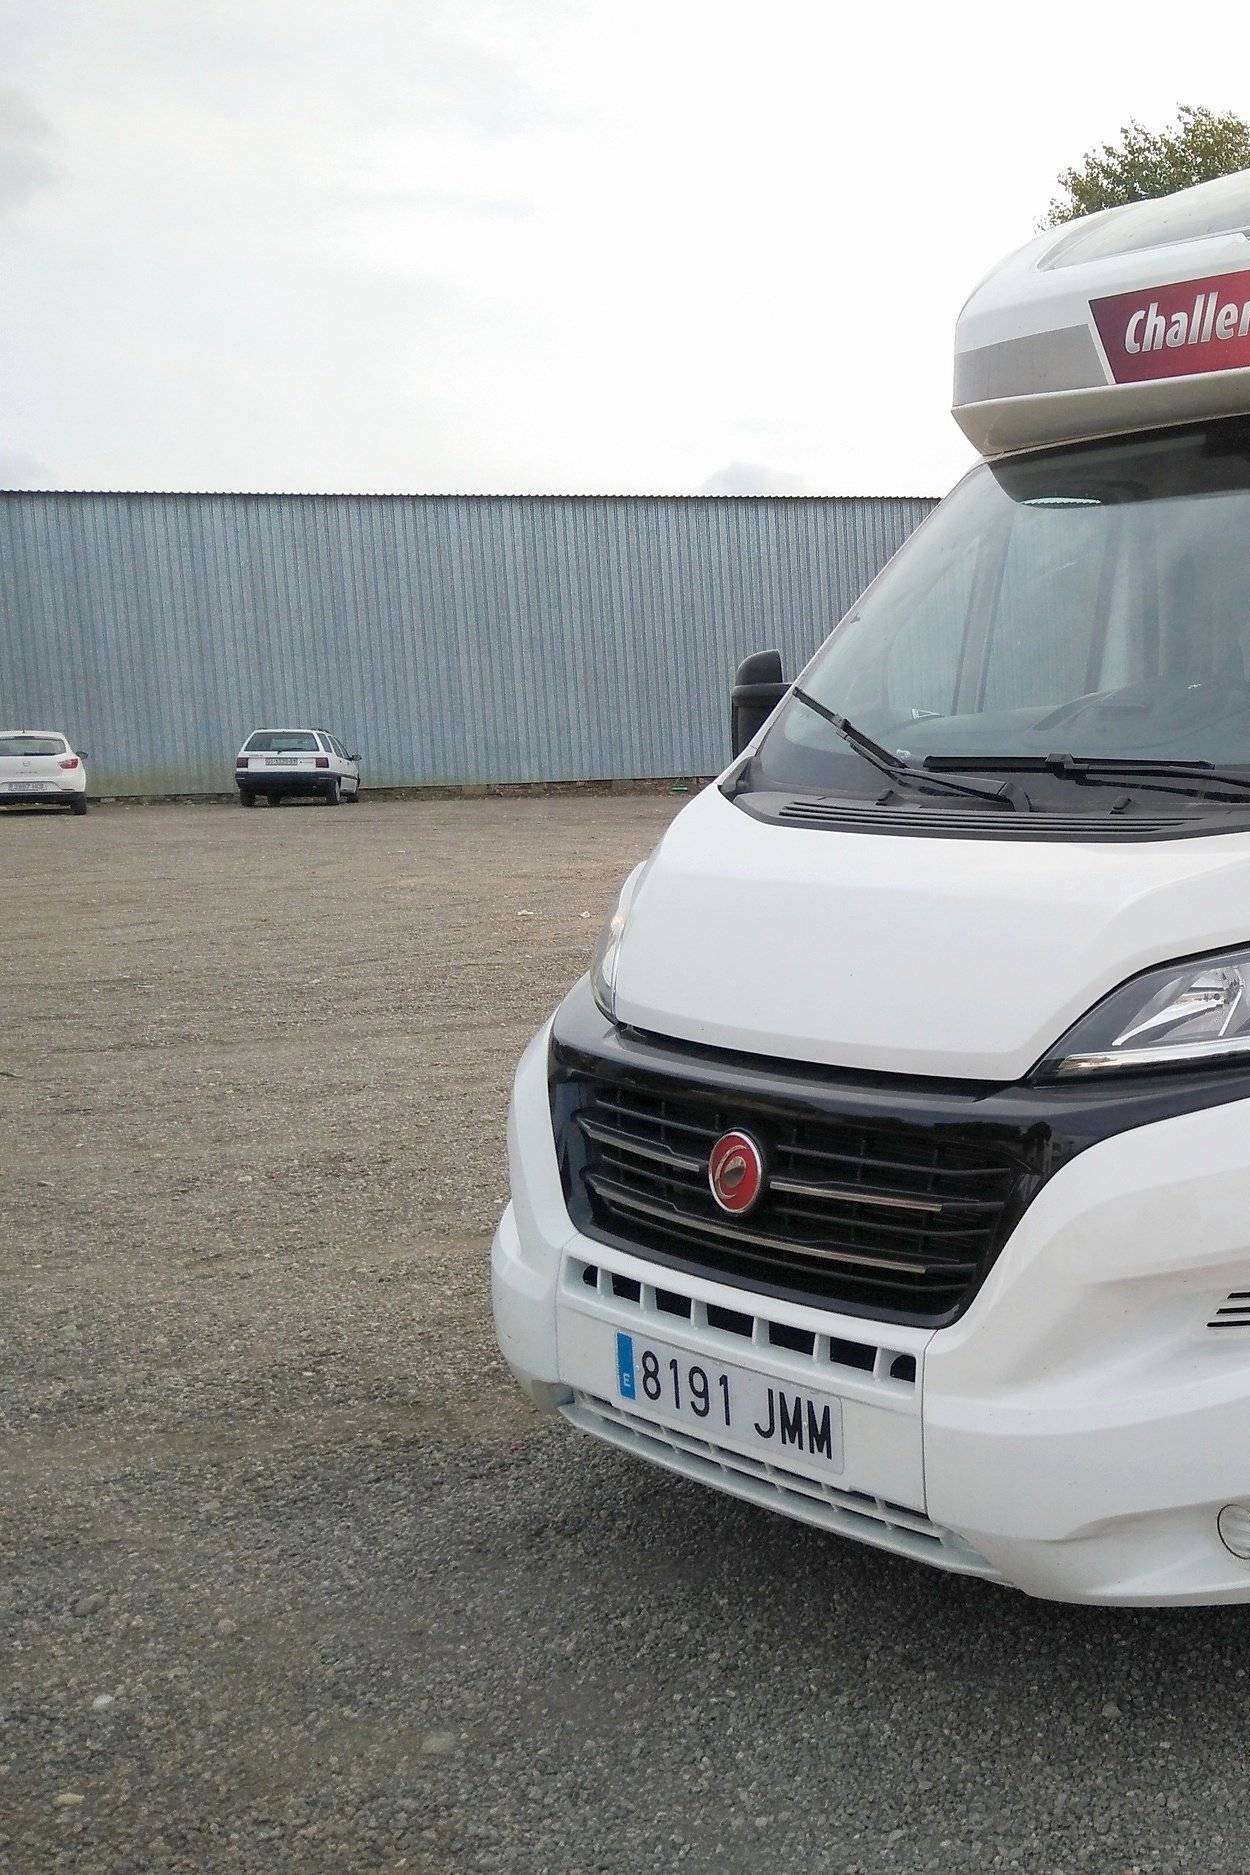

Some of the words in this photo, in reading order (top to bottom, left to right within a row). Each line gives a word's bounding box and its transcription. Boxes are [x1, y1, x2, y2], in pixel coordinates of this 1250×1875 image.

[623, 1372, 631, 1388] E
[642, 1350, 731, 1426] 8191
[754, 1388, 833, 1460] JMM
